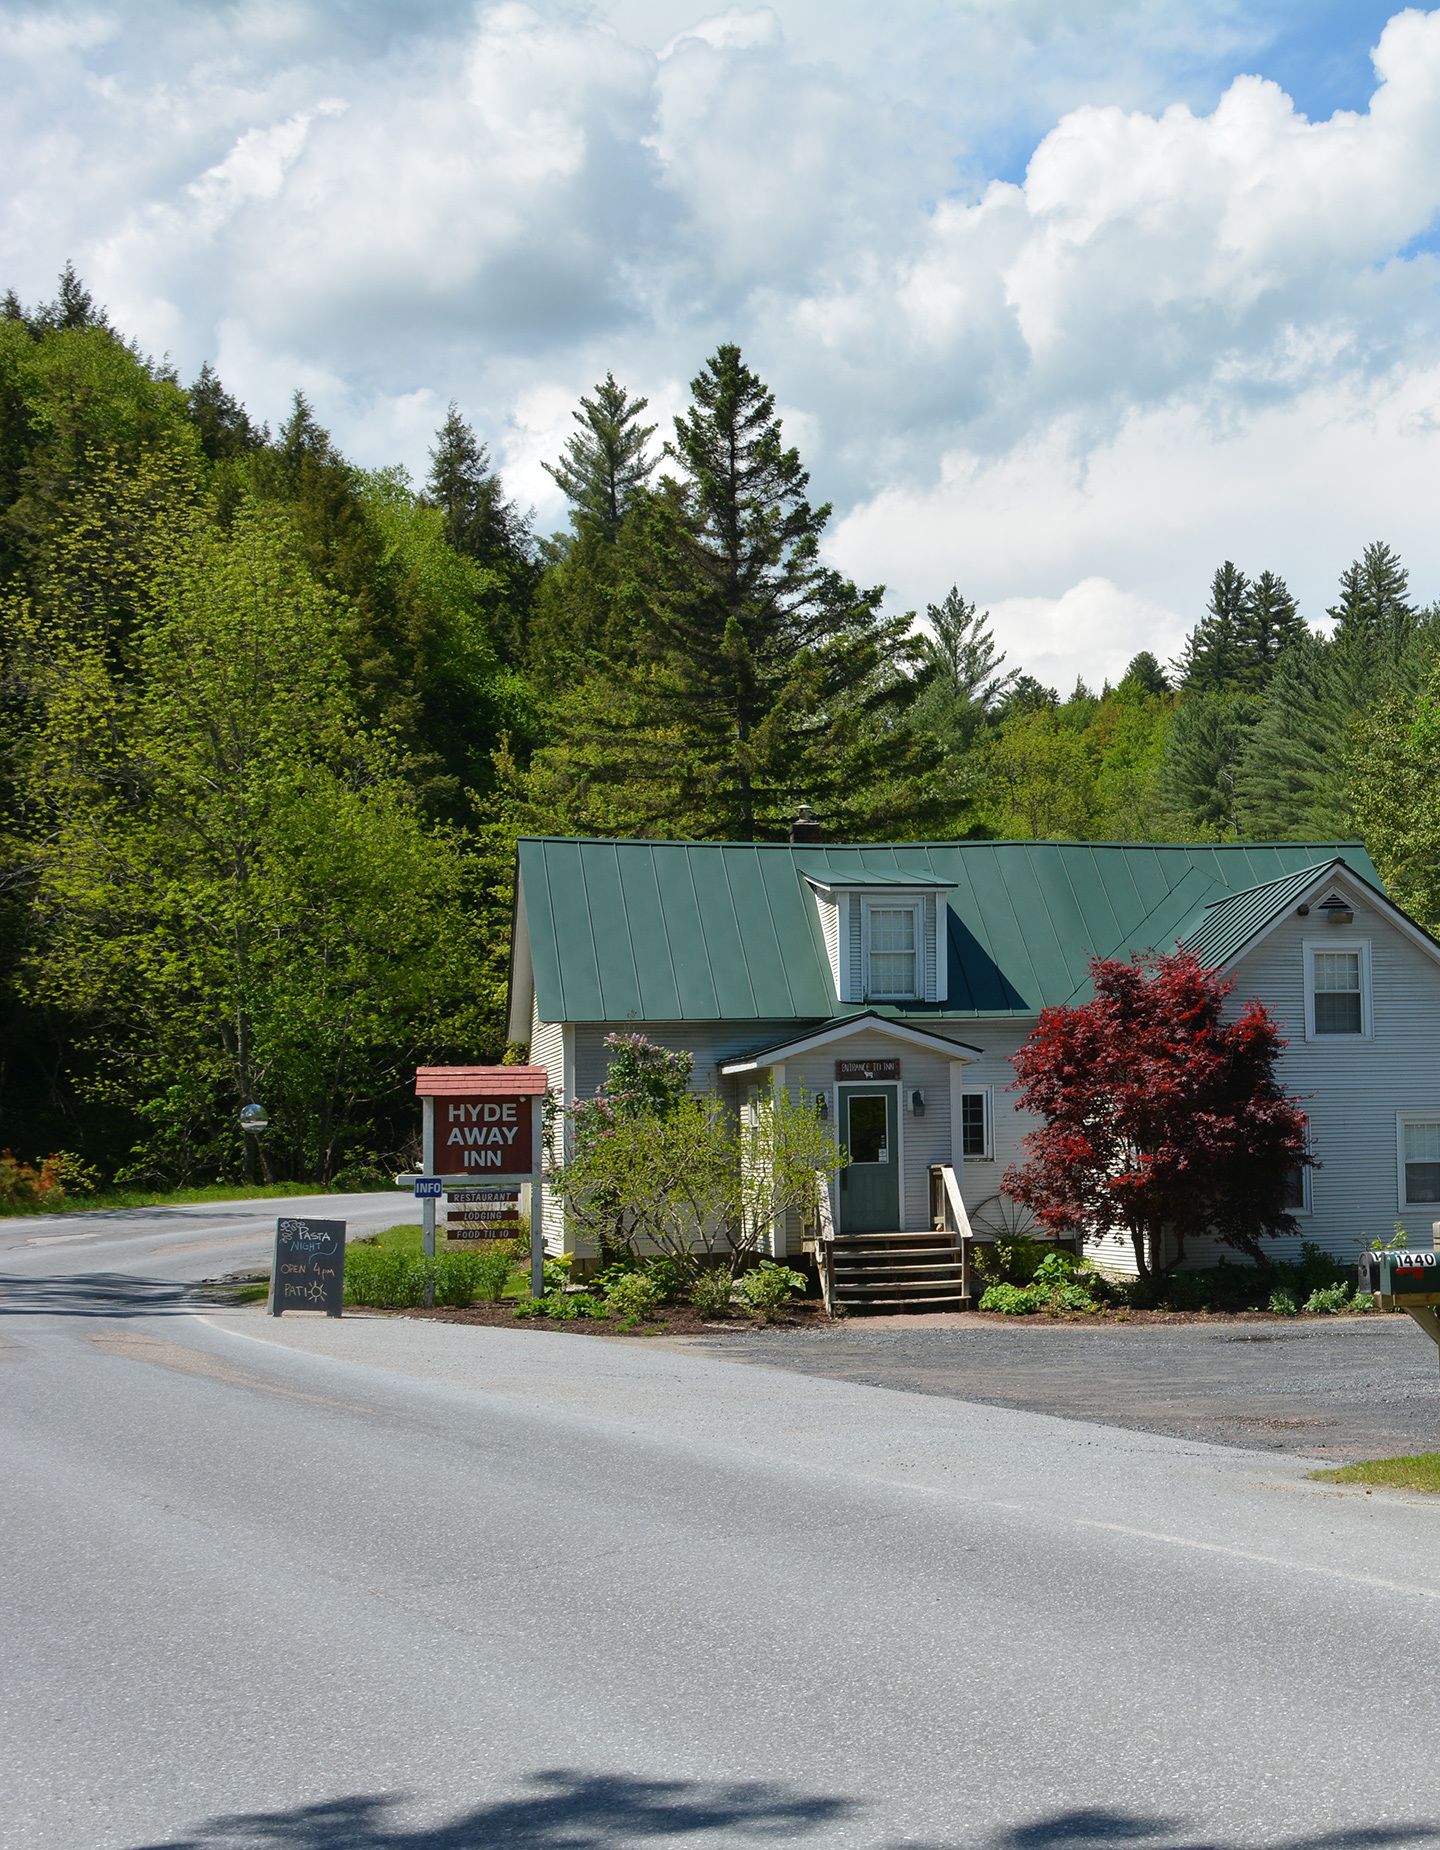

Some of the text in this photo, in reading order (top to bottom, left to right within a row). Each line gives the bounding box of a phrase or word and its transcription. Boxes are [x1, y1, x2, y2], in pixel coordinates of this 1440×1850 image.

[841, 1062, 895, 1072] ENTRANCE TO INN
[448, 1103, 518, 1122] HYDE
[446, 1127, 519, 1146] AWAY
[463, 1150, 502, 1167] INN
[416, 1182, 441, 1193] INFO
[454, 1192, 512, 1202] RESTAURANT
[464, 1211, 502, 1220] LODGING
[299, 1226, 331, 1242] PASTA
[456, 1229, 509, 1239] FOOD TIL 10
[290, 1241, 321, 1252] NIGHT
[1397, 1254, 1434, 1267] 1440
[281, 1263, 306, 1274] OPEN
